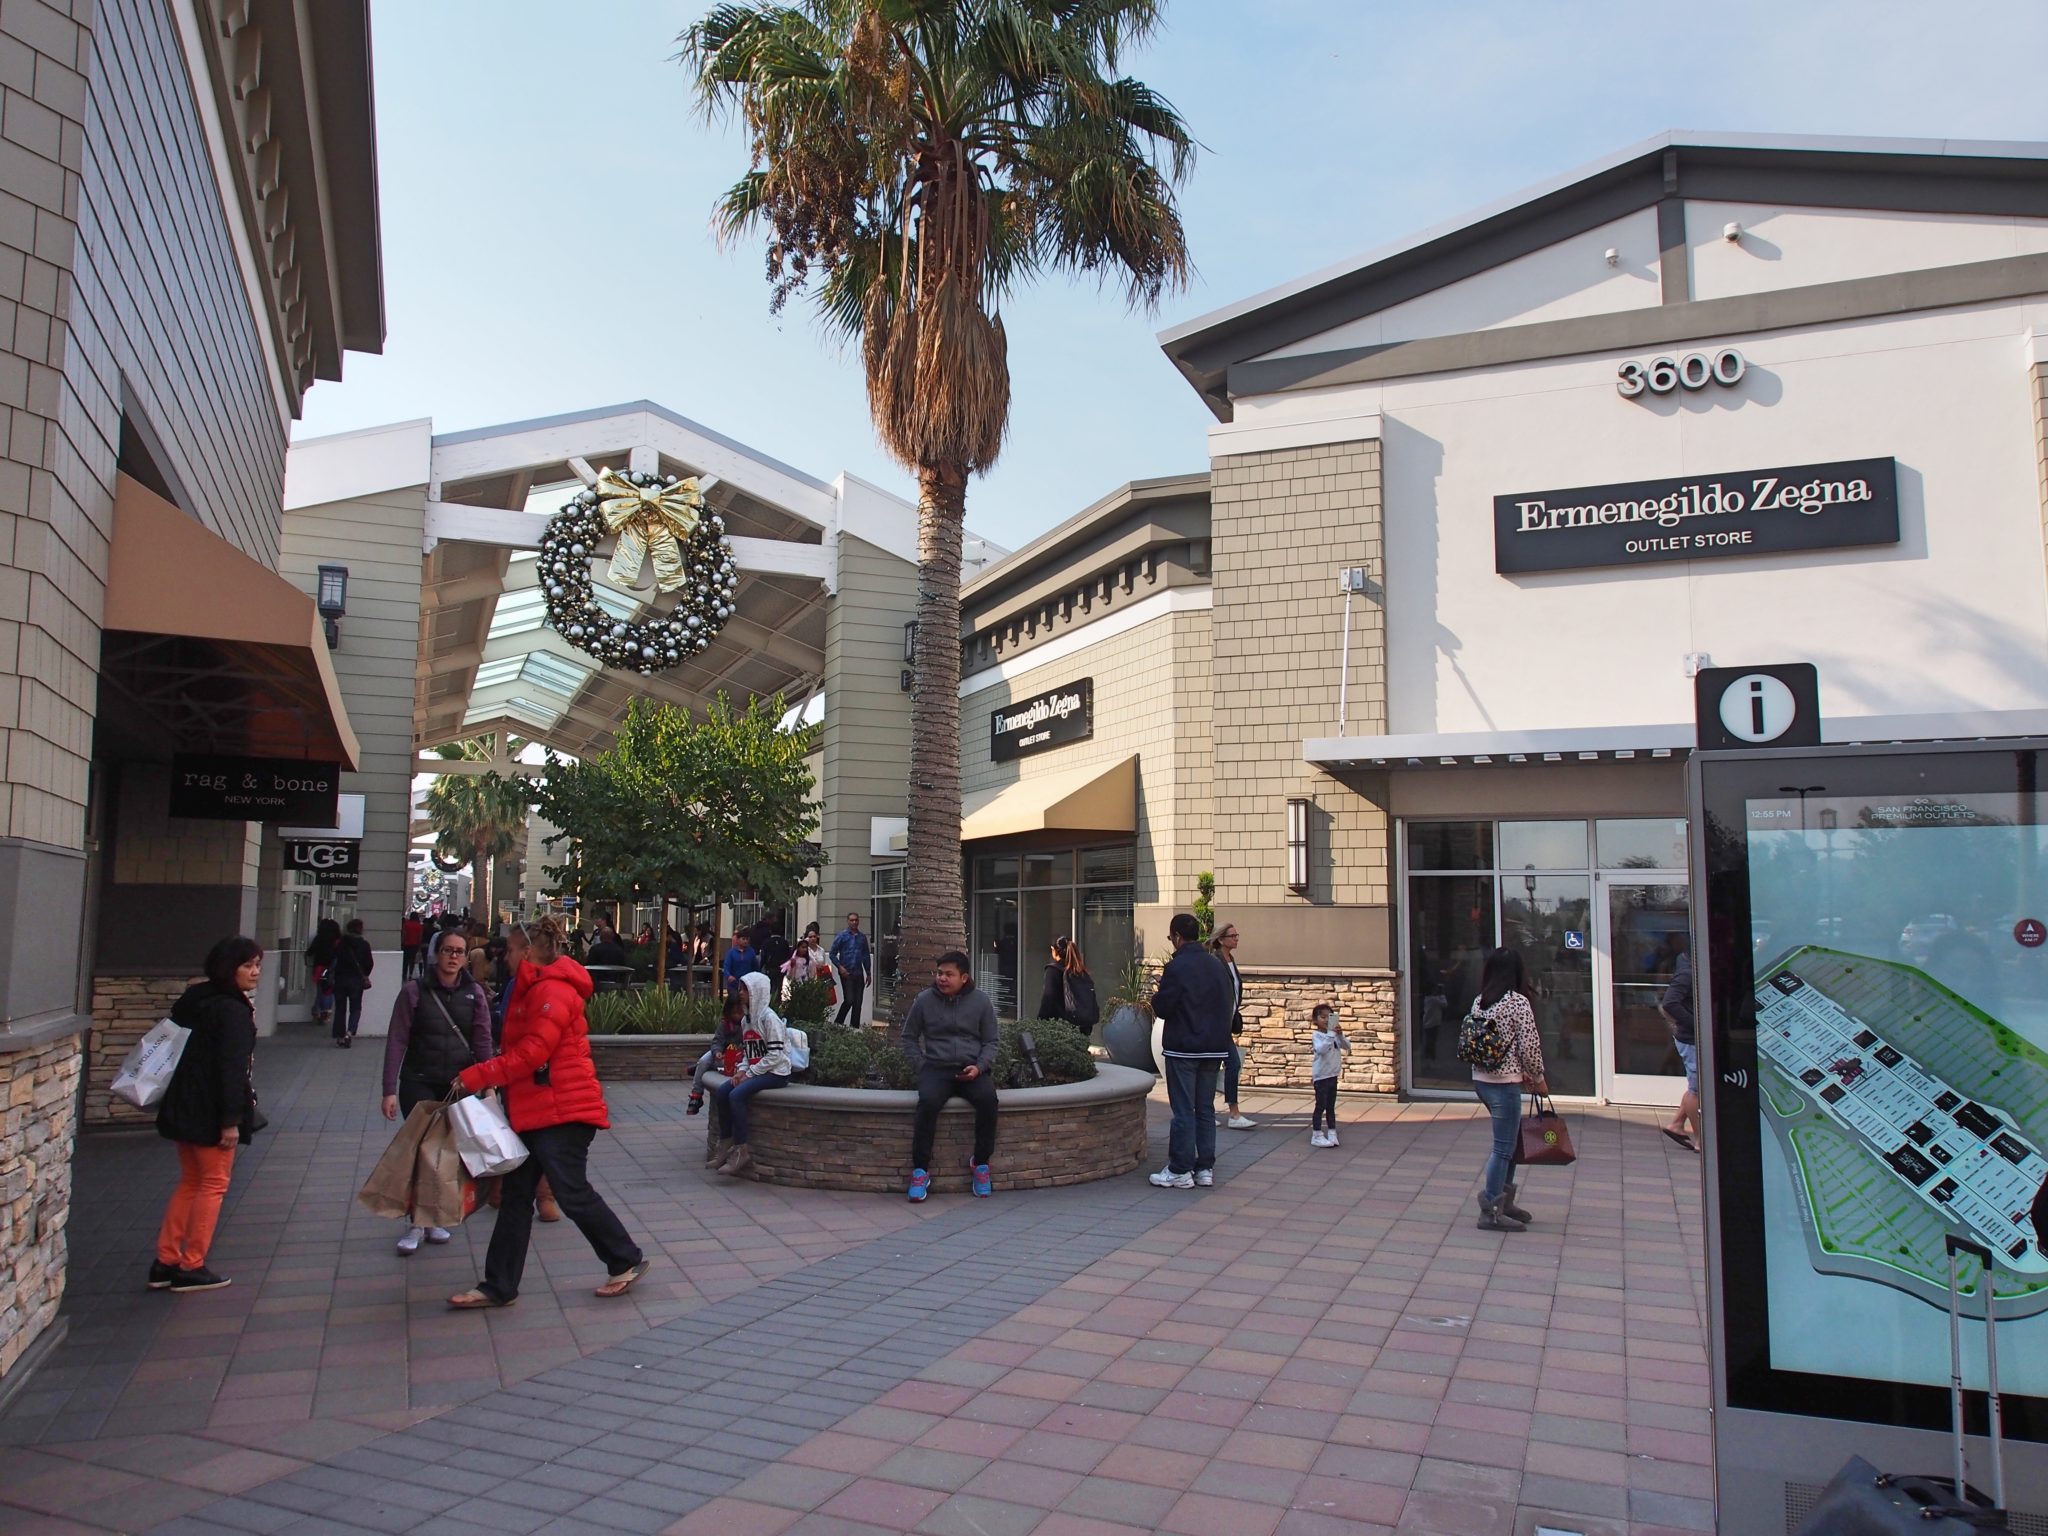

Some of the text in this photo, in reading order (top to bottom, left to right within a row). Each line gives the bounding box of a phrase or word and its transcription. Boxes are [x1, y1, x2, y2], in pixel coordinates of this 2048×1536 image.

[1617, 349, 1745, 398] 3600
[1515, 478, 1872, 532] Ermenegildo Zegna
[1625, 530, 1752, 553] OUTLET STORE
[995, 692, 1081, 735] Ermenegildo Zegna
[1019, 731, 1051, 747] OUTLET STORE
[184, 773, 329, 792] rag & bone
[225, 795, 286, 806] NEW YORK
[1903, 804, 1968, 812] FRANCISCO
[1751, 810, 1791, 819] 12:55 PM
[1871, 811, 1976, 821] PREMIUM OUTLETS
[294, 844, 349, 868] UGG
[139, 1049, 154, 1066] POLO
